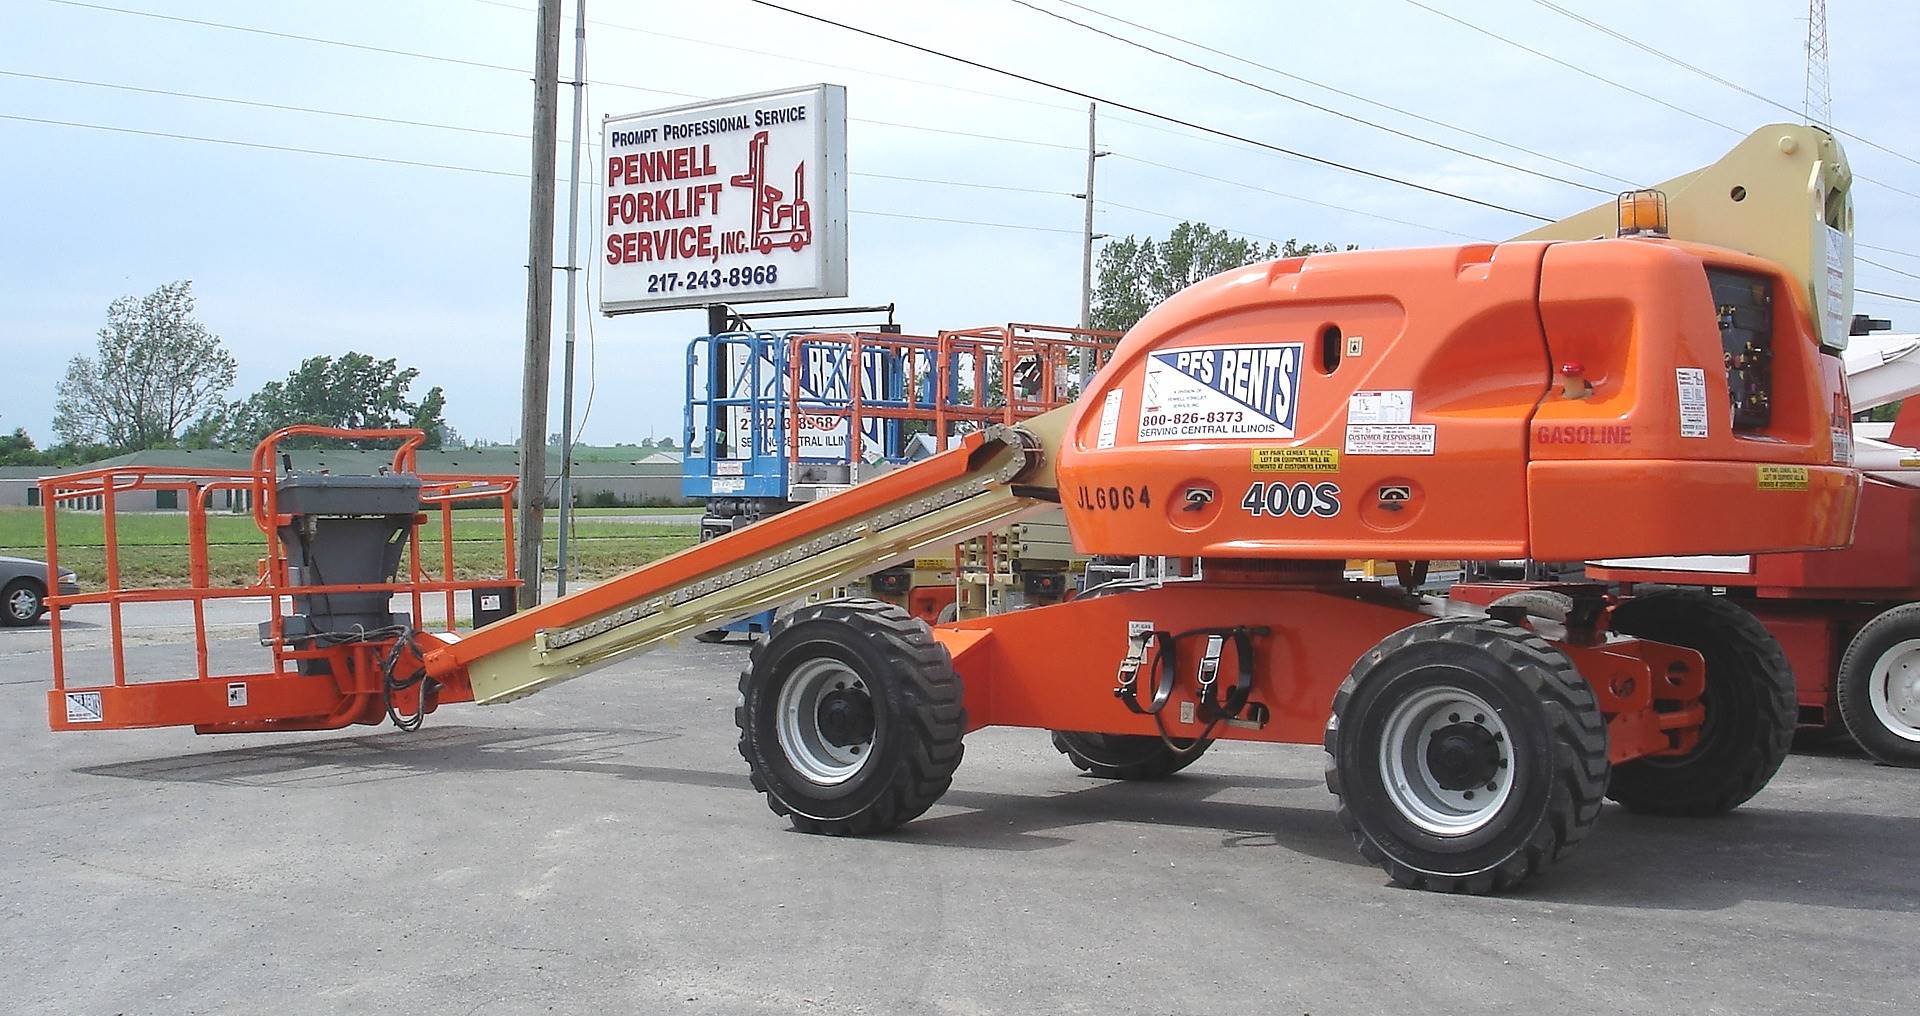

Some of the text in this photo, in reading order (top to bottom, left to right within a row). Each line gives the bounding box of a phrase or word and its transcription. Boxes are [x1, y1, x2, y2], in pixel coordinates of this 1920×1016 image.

[612, 106, 806, 148] PROMPT PROFESSIONAL SERVICE
[608, 144, 717, 187] PENNELL
[607, 183, 723, 226] FORKLIFT
[606, 225, 749, 265] SERVICE, INC.
[647, 264, 778, 293] 217-243-8968
[1177, 347, 1294, 425] PFS RENTS
[1140, 424, 1276, 438] SERVING CENTRAL ILLINOIS
[1142, 411, 1244, 427] 800-826-8373
[1537, 426, 1632, 444] GASOLINE
[1078, 486, 1151, 511] JLG064
[1242, 482, 1341, 517] 400S
